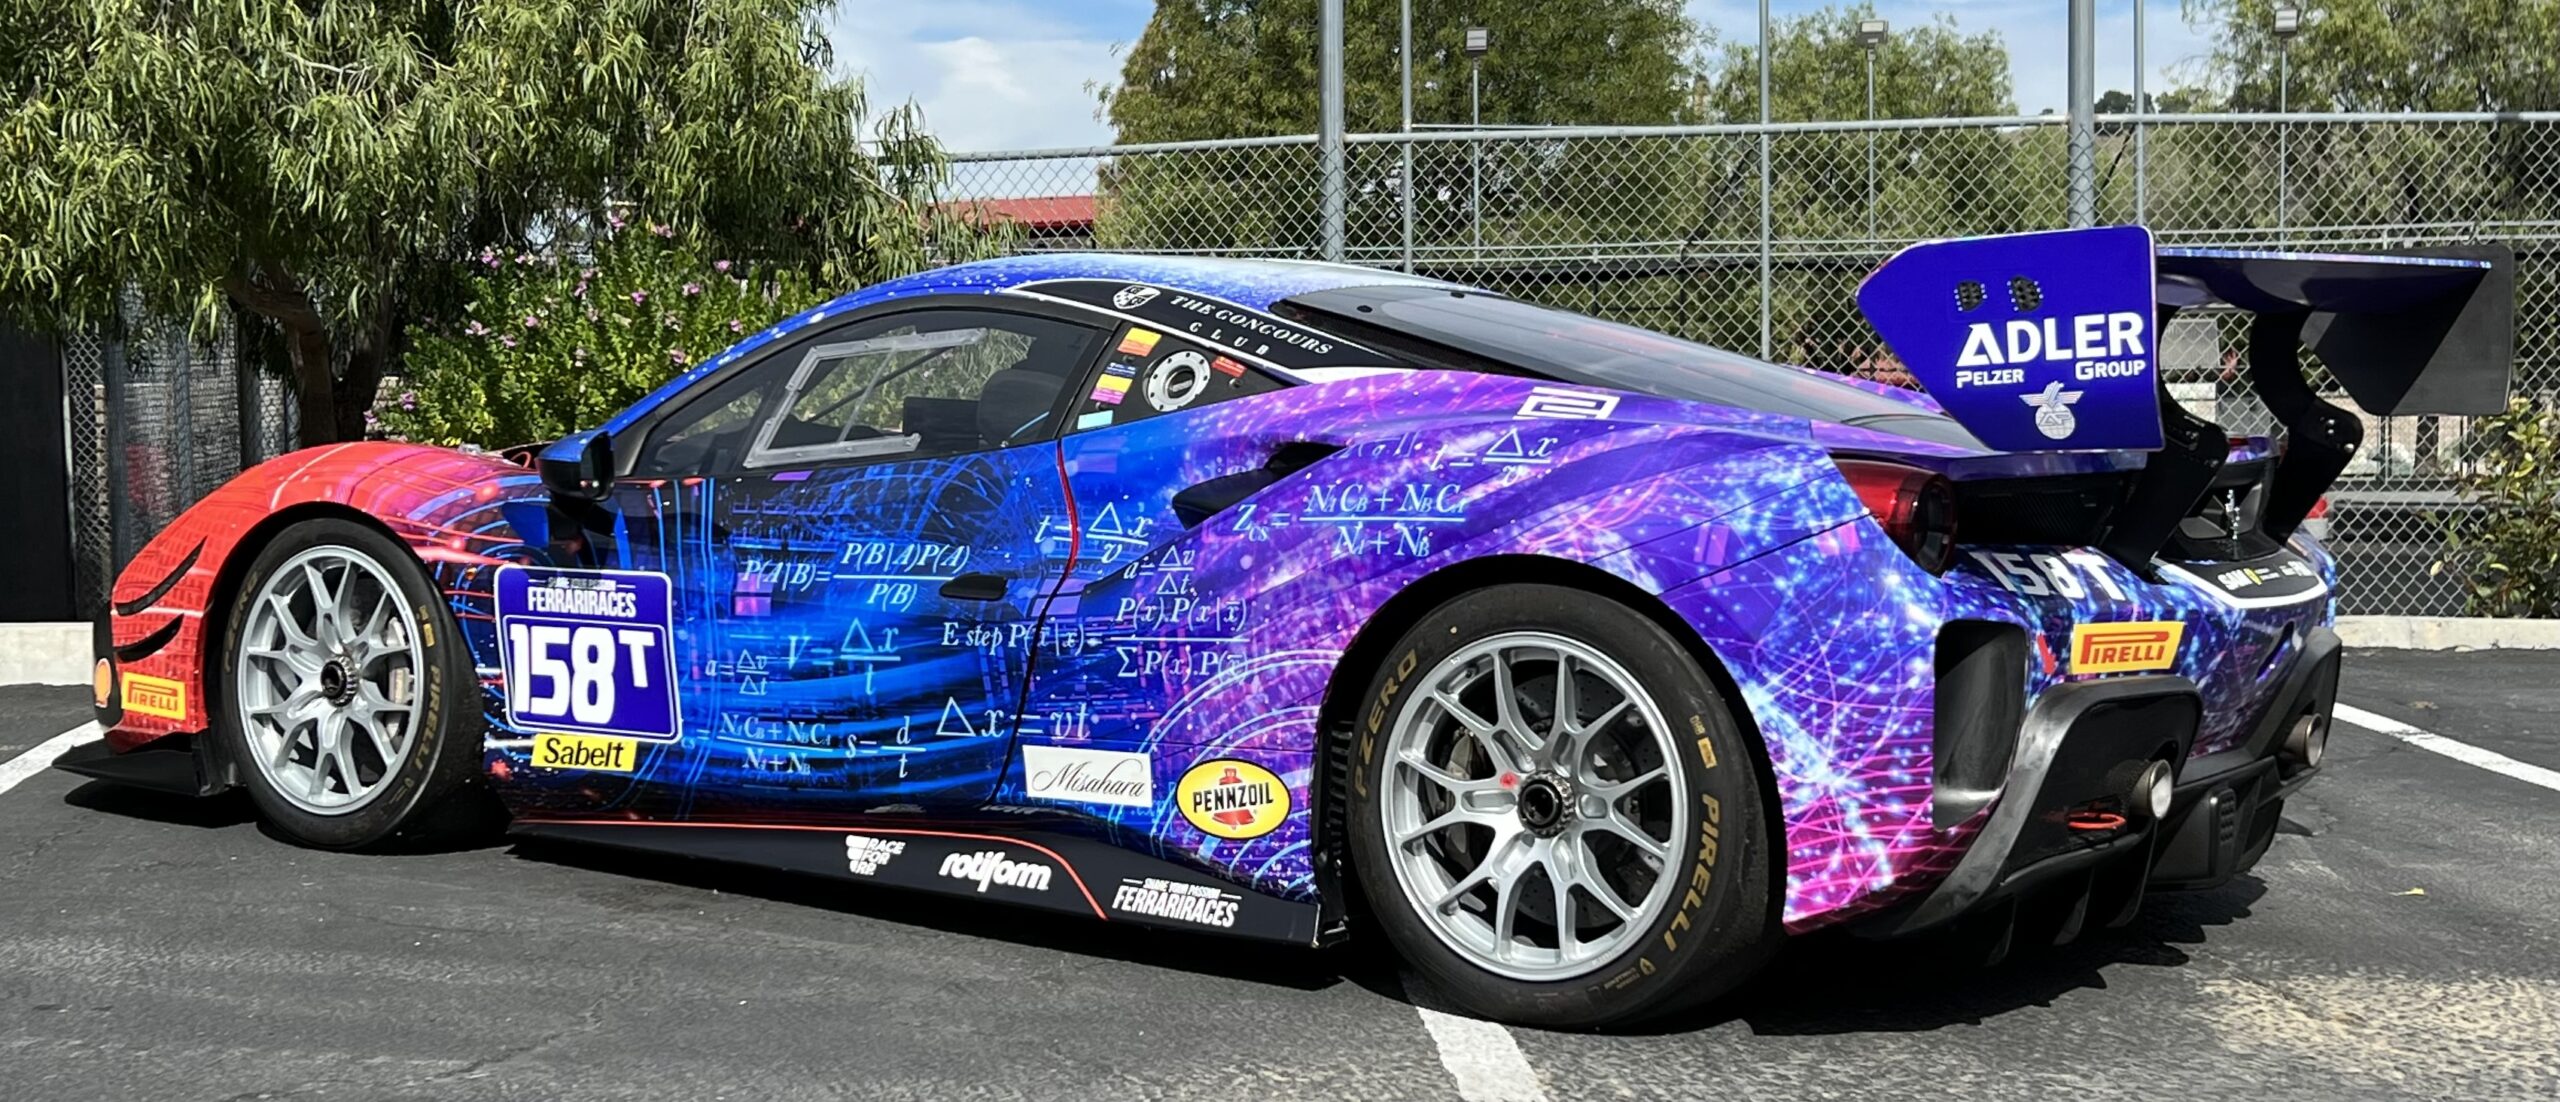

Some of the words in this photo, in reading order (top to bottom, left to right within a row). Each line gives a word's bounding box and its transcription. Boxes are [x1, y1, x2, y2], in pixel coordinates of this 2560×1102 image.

[1170, 295, 1216, 315] THE
[1214, 309, 1334, 355] CONCOURS
[1956, 312, 2145, 367] ADLER
[527, 586, 637, 618] FERRARIRACES
[965, 625, 1003, 655] step
[2080, 631, 2169, 665] PIRELLI
[127, 680, 178, 712] PIRELLI
[414, 664, 441, 770] PIRELLI
[544, 738, 624, 768] Sabelt
[1031, 758, 1147, 799] Misahara
[1193, 782, 1275, 813] PENNZOIL
[861, 851, 891, 865] FOR
[867, 838, 906, 855] RACE
[938, 851, 1052, 893] rotiform
[1664, 793, 1720, 952] PIRELLI
[1111, 885, 1240, 928] FERRARIRACES
